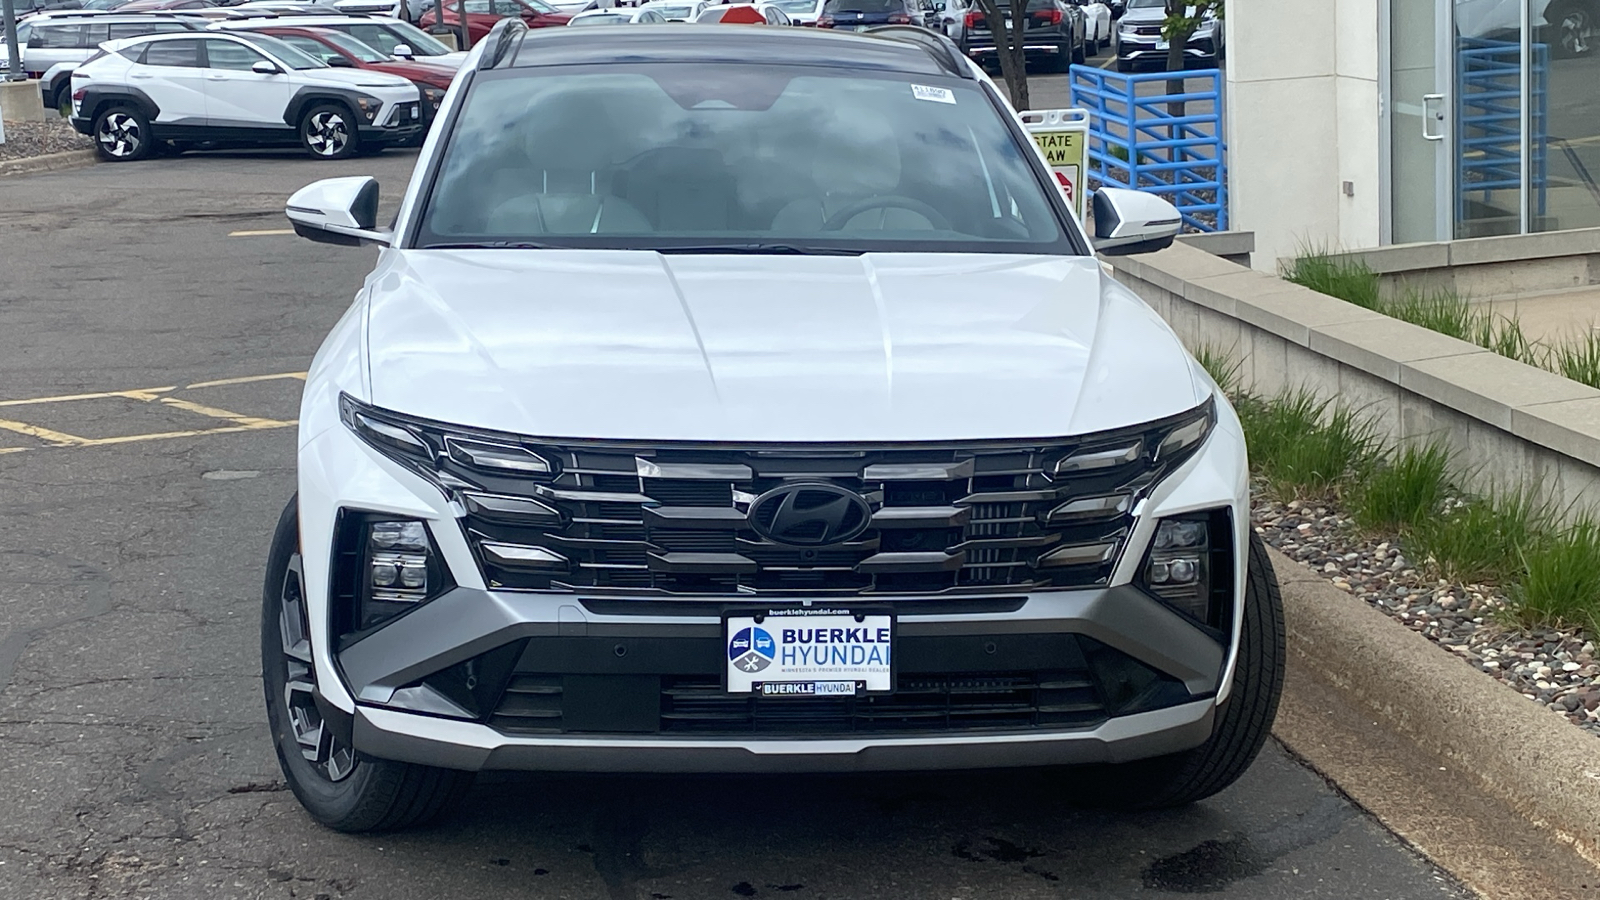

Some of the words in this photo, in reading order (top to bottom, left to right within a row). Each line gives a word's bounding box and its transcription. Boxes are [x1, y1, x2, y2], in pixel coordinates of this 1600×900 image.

[1046, 150, 1066, 161] AW
[782, 628, 890, 644] BUERKLE
[782, 645, 890, 666] HYUNDAI
[764, 683, 815, 694] BUERKLE
[816, 683, 854, 693] HYUNDAI
